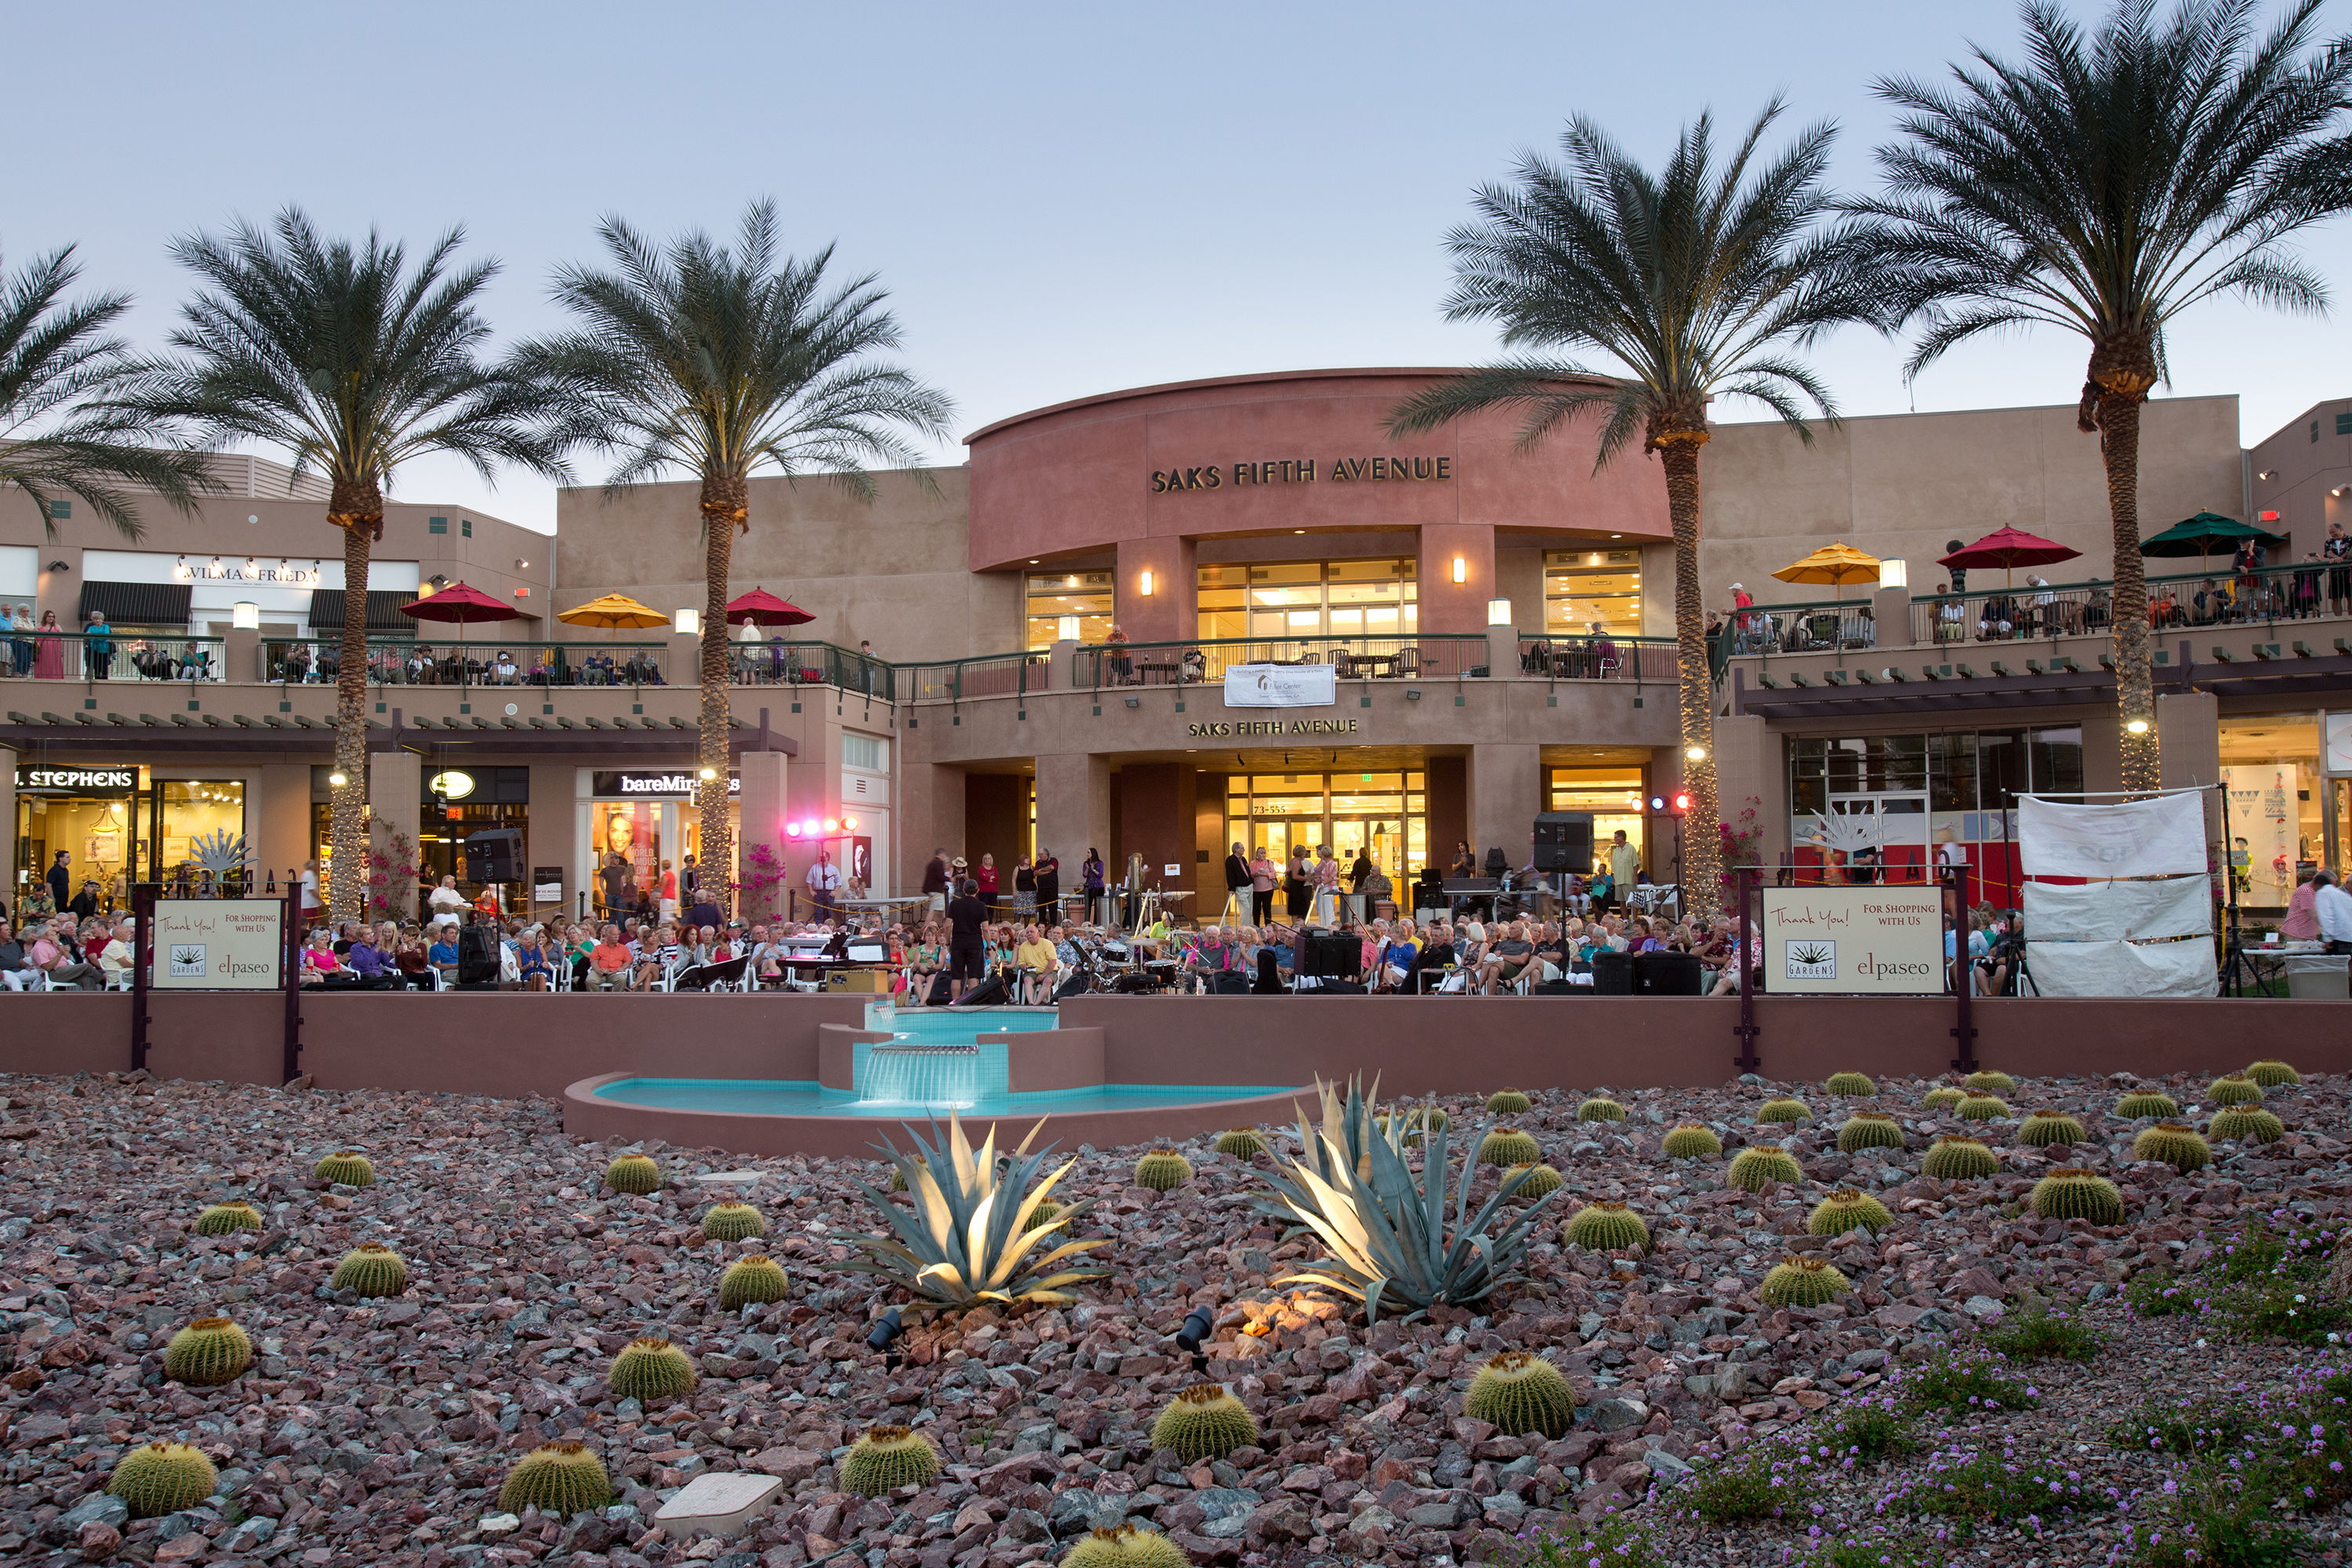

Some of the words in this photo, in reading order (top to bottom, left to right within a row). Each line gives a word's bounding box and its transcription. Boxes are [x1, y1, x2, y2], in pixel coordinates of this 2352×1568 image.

[1152, 466, 1221, 493] SAKS
[1234, 459, 1316, 485] FIFTH
[1331, 457, 1451, 481] AVENUE
[184, 567, 244, 580] WILMA
[245, 571, 256, 579] &
[258, 569, 317, 583] FRIEDA
[1189, 722, 1230, 736] SAKS
[1236, 721, 1283, 735] FIFTH
[1290, 719, 1357, 734] AVENUE
[30, 771, 132, 786] STEPHENS
[1254, 806, 1286, 815] 73-555
[627, 848, 654, 857] WORLD
[628, 857, 658, 866] FAMOUS
[159, 916, 191, 932] Thank
[194, 918, 216, 936] You!
[1769, 906, 1815, 927] Thank
[1819, 908, 1849, 931] You!
[172, 964, 204, 973] GARDENS
[1789, 964, 1833, 975] GARDENS
